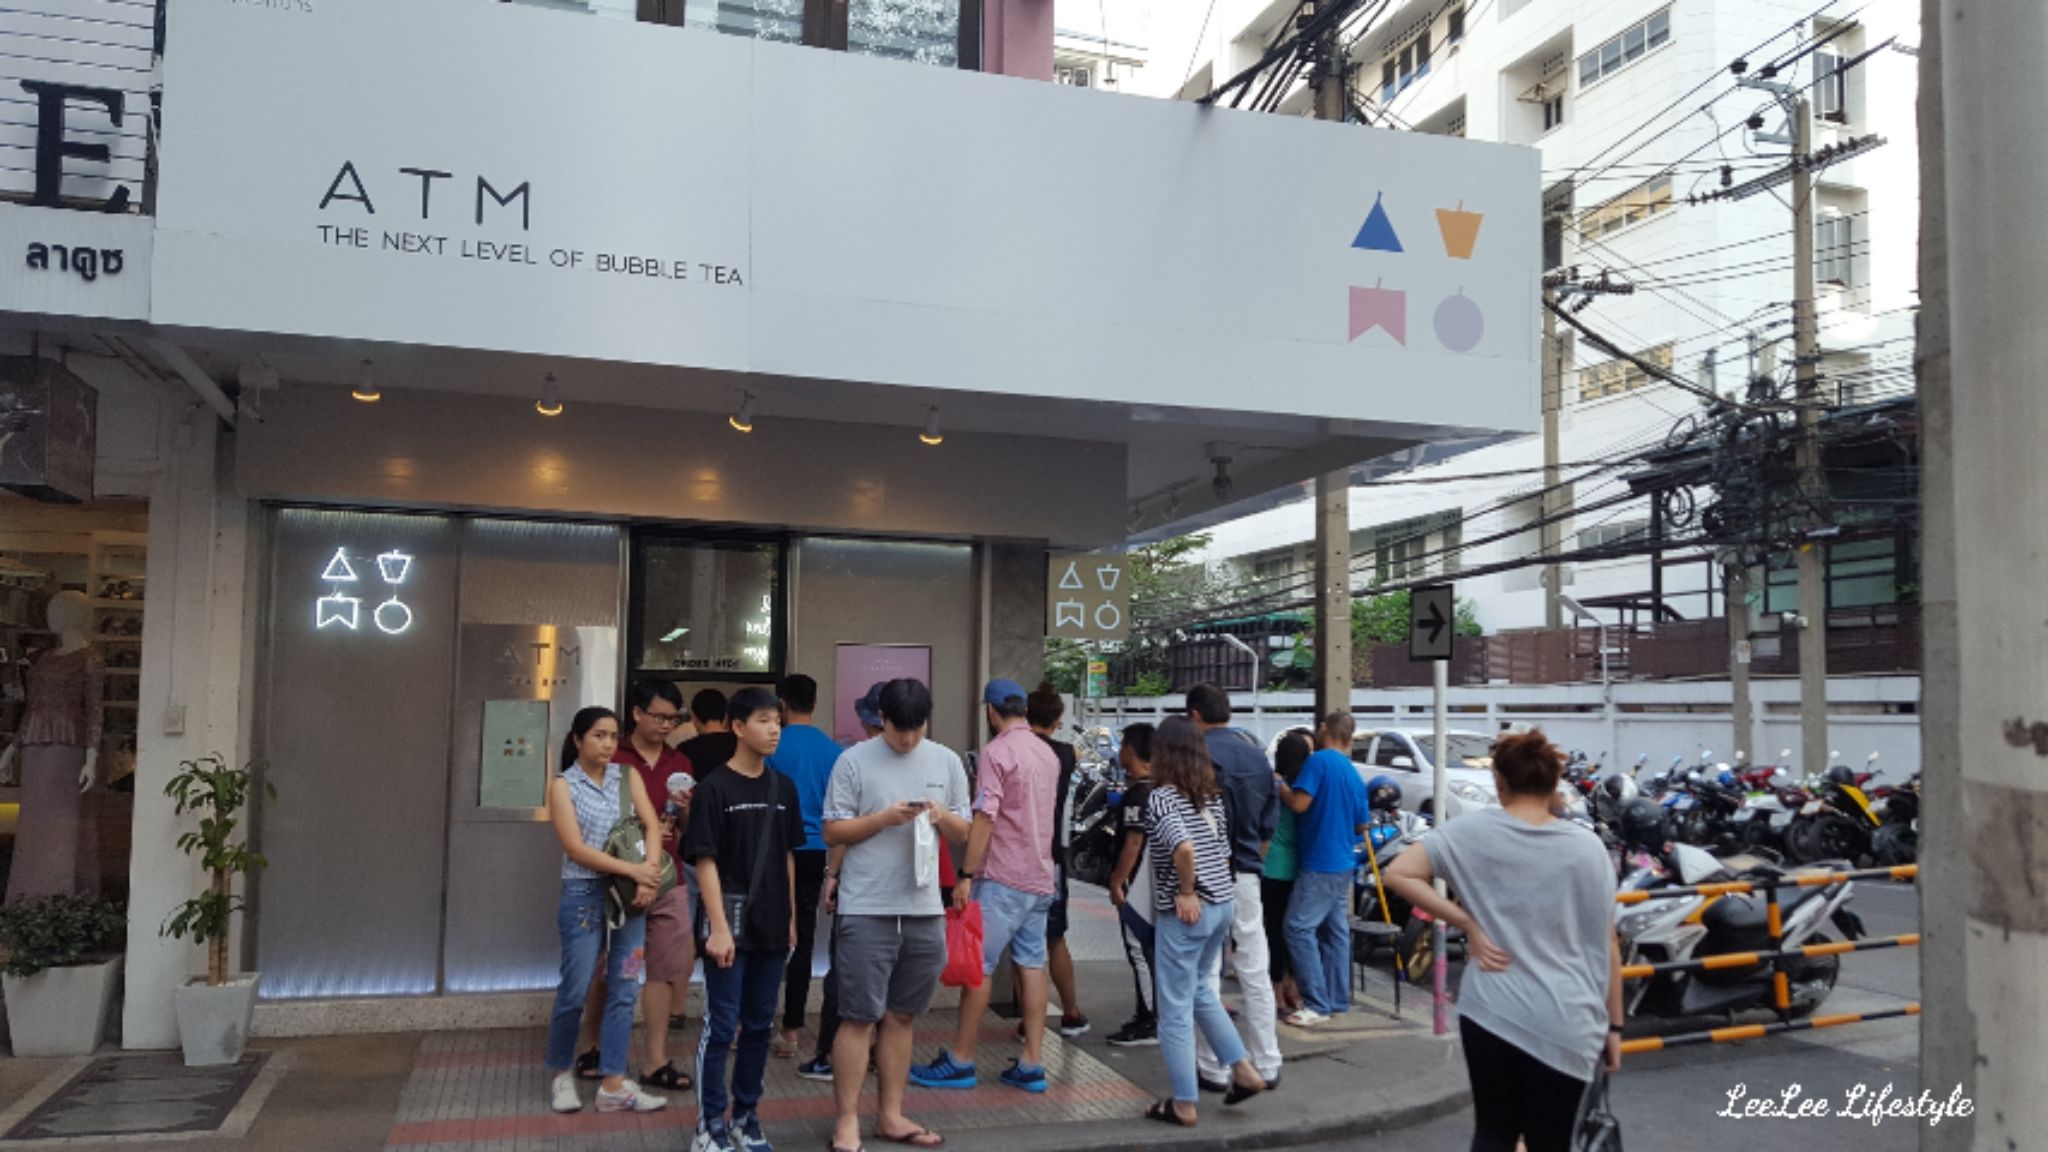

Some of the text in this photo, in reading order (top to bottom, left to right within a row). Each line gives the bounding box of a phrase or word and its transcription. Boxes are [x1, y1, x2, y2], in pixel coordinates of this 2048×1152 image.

[319, 160, 529, 231] ATM
[317, 224, 744, 286] THE NEXT LEVEL OF BUBBLE TEA
